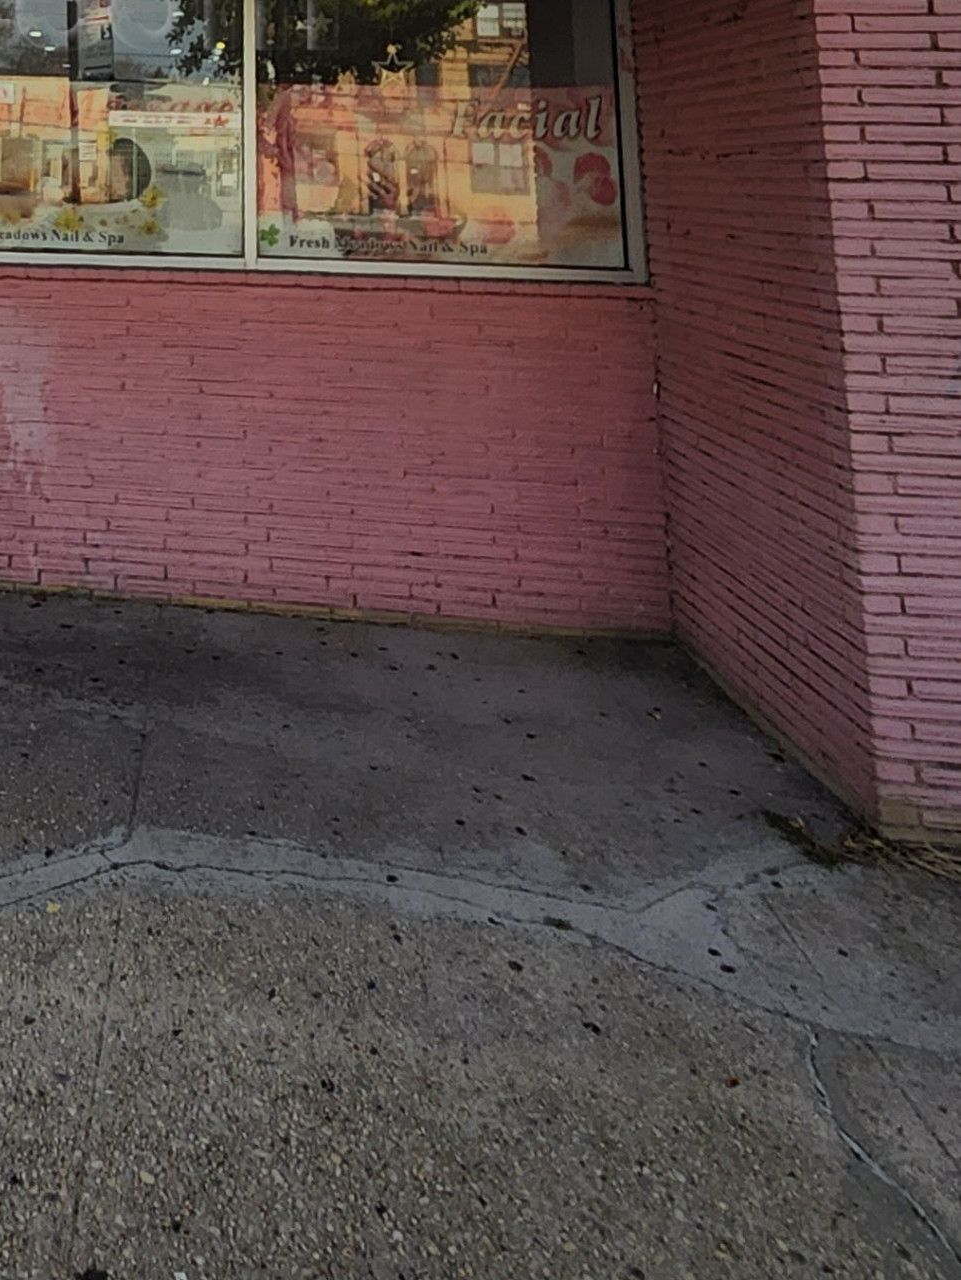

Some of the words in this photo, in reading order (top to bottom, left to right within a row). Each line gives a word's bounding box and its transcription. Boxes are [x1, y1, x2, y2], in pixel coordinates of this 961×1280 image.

[450, 97, 601, 140] Facial
[51, 229, 79, 243] Nail
[82, 231, 95, 243] &
[99, 231, 125, 246] Spa
[289, 235, 330, 249] Fresh
[459, 242, 488, 256] Spa
